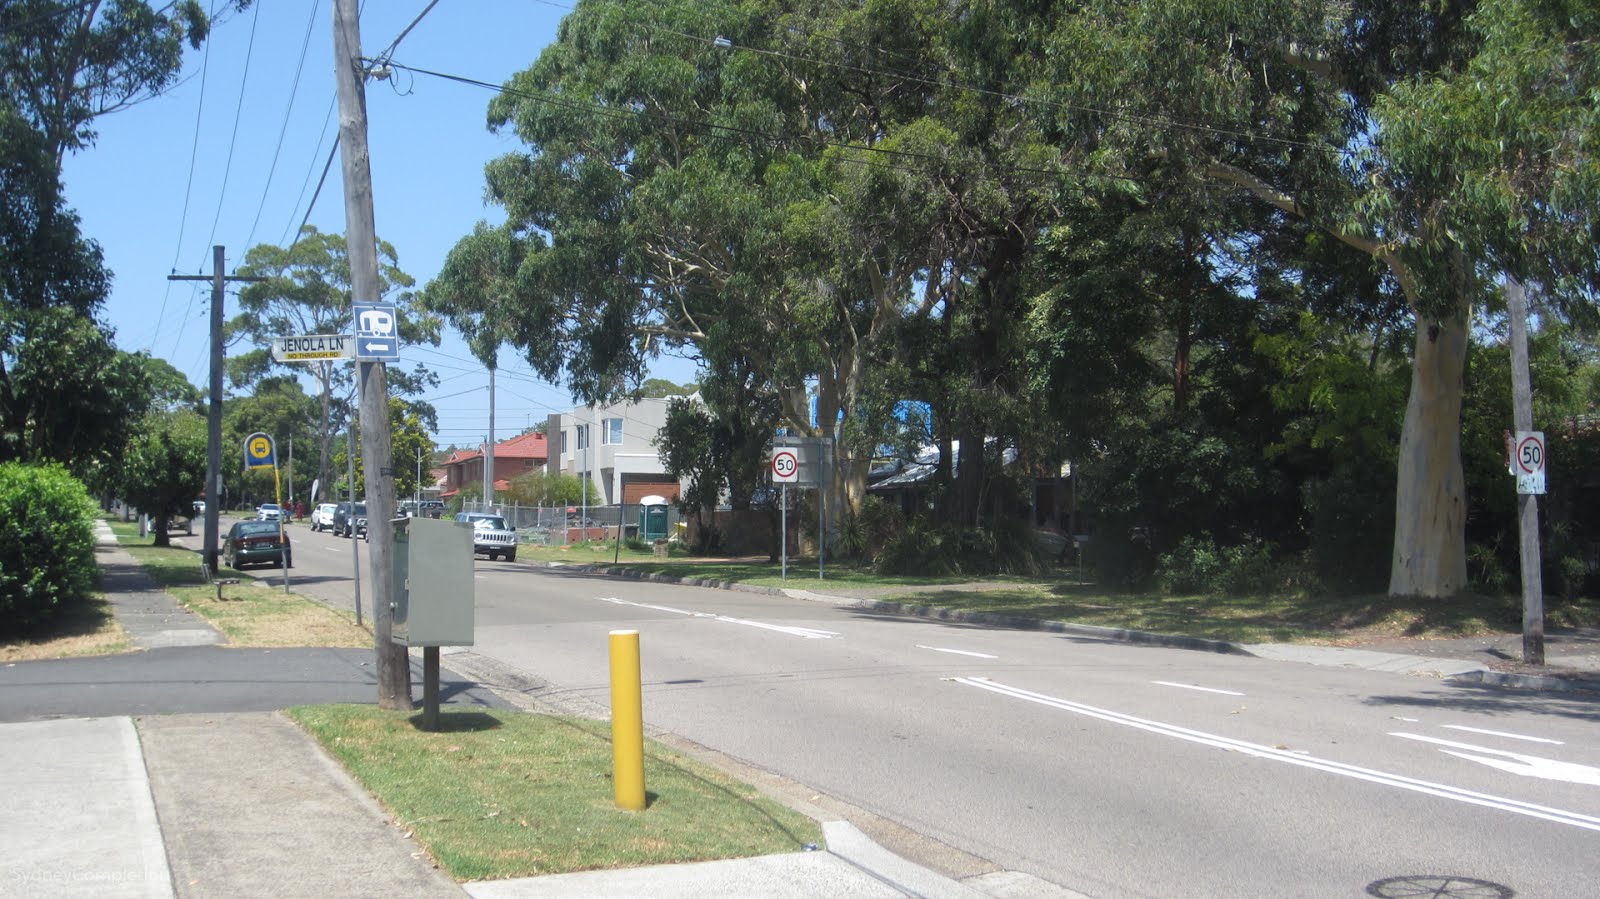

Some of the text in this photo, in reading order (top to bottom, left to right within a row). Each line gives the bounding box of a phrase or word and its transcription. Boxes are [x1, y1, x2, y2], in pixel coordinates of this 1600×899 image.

[281, 337, 344, 352] JENOLA LN
[1523, 446, 1540, 464] 50
[777, 460, 793, 470] 50
